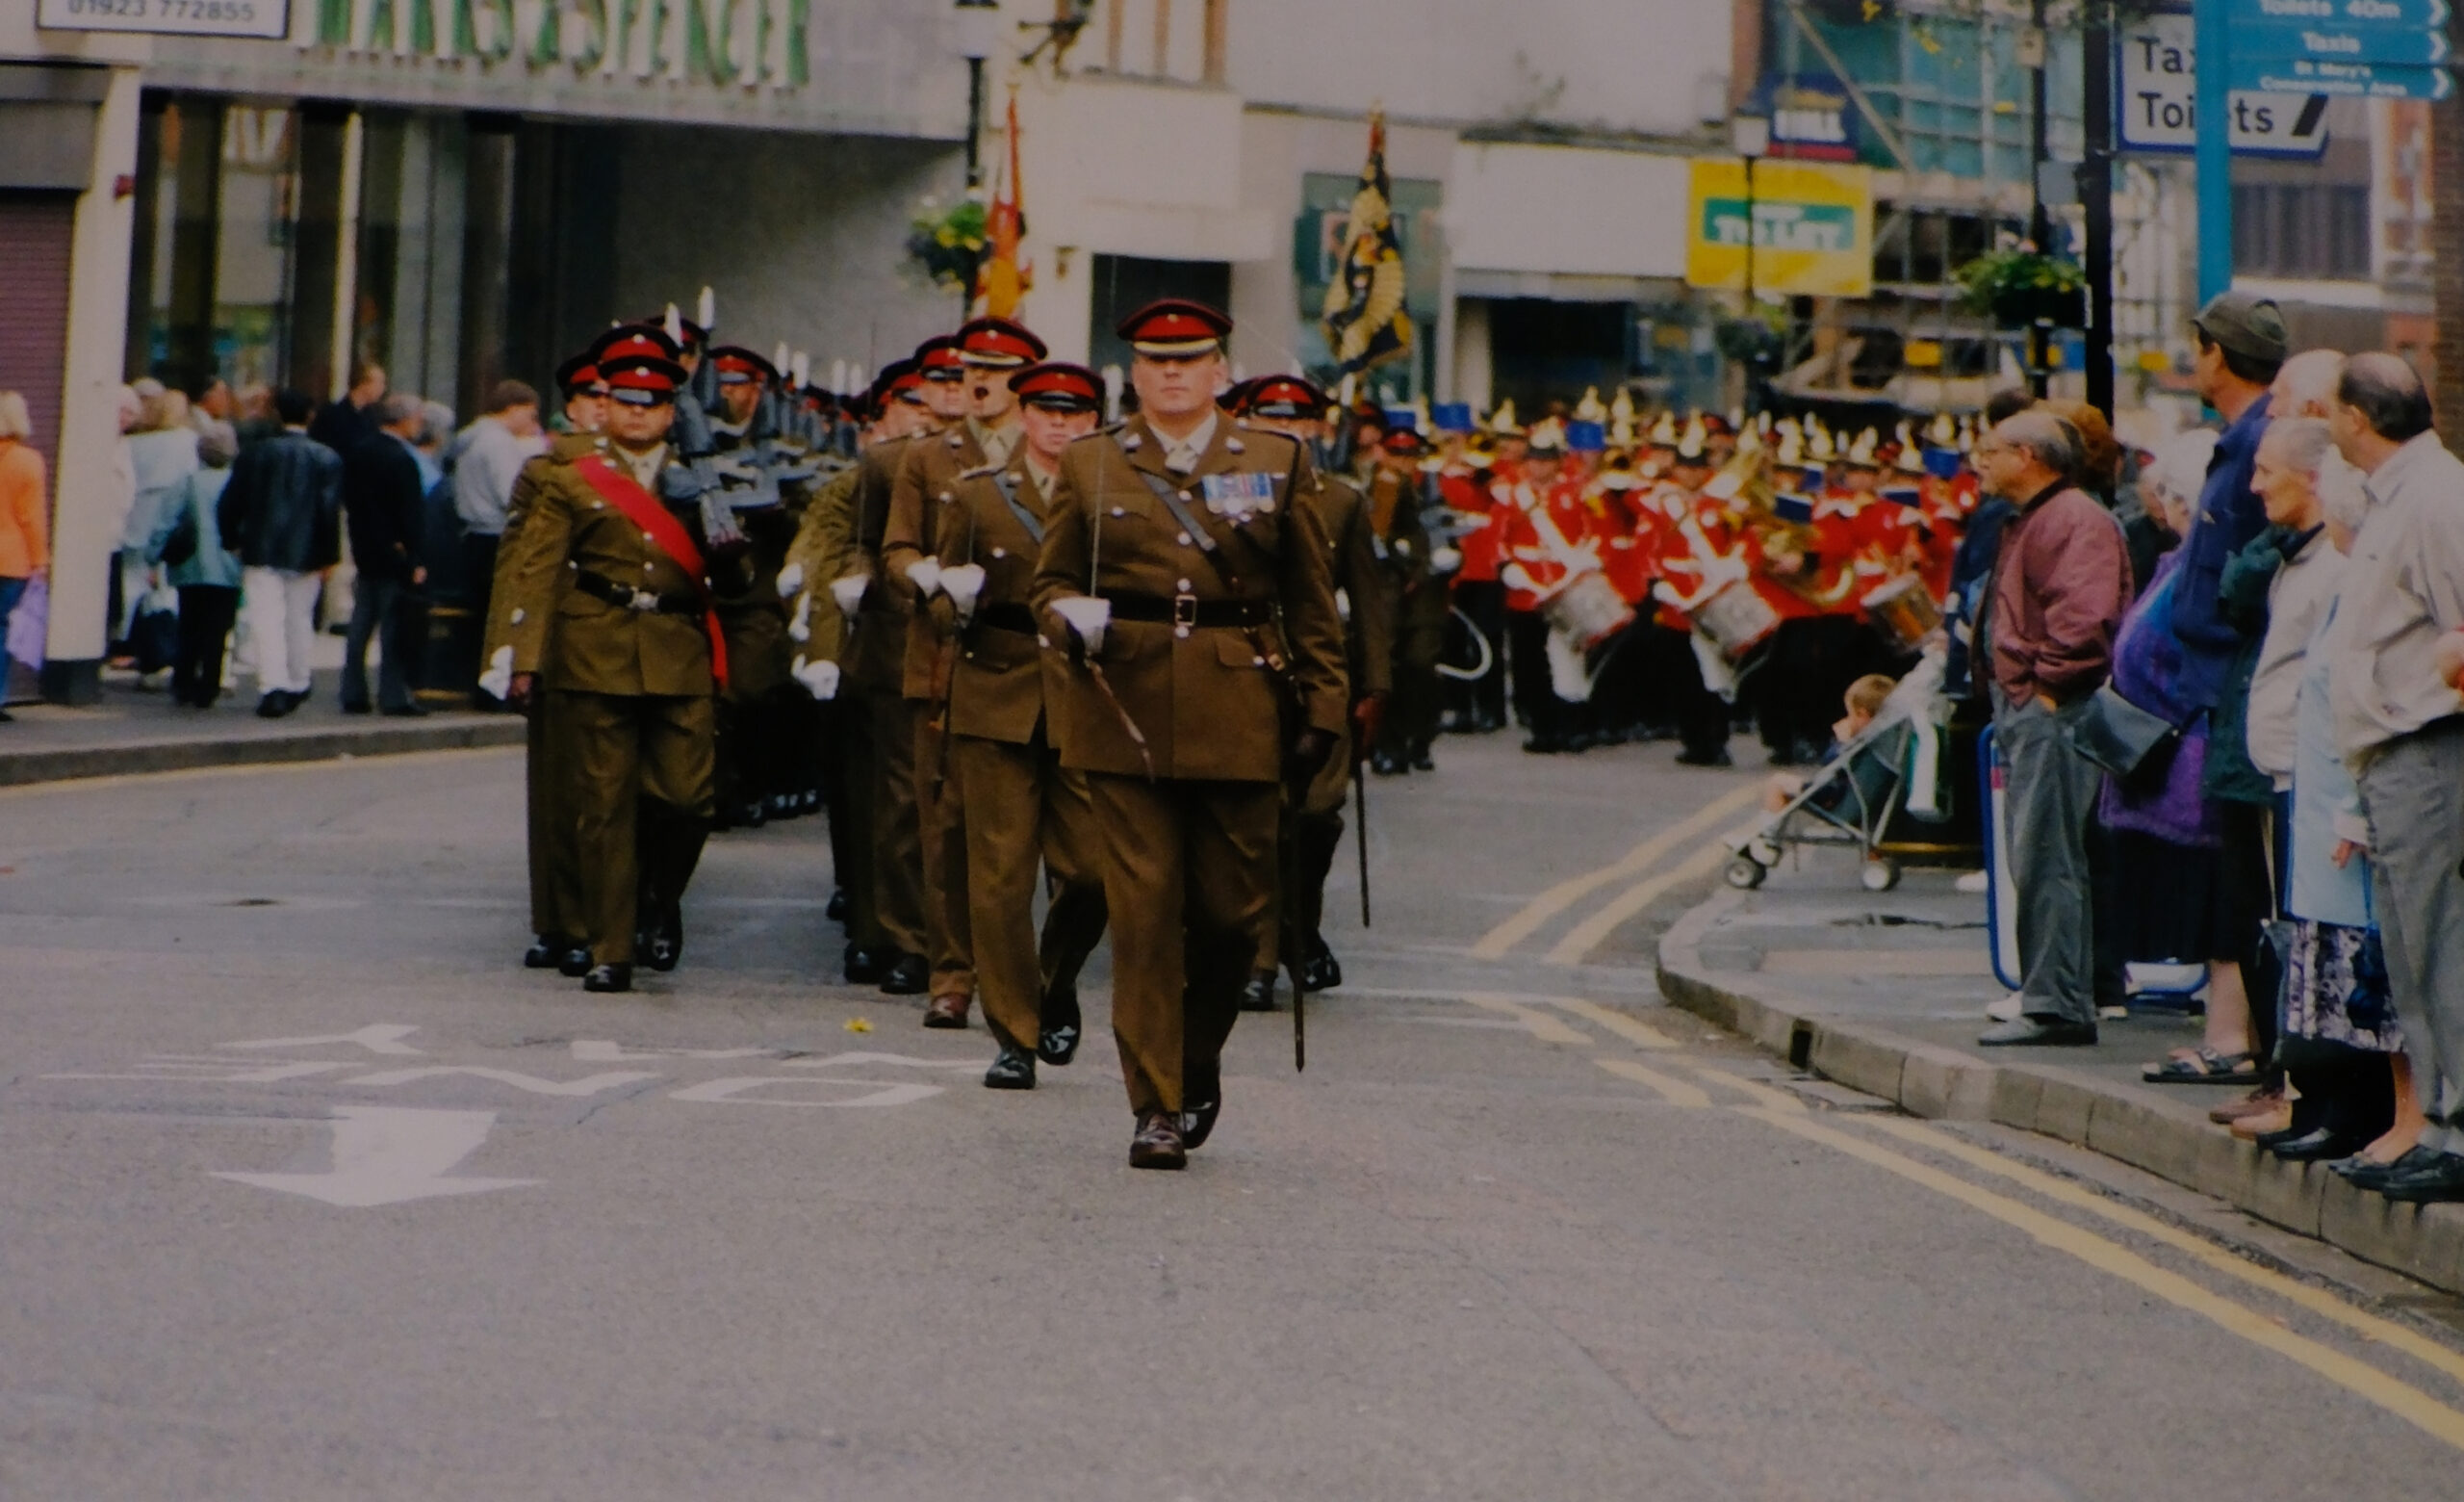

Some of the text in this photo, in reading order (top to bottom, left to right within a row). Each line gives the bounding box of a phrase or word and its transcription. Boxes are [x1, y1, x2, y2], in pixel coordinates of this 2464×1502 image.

[160, 0, 255, 21] 772855
[2138, 91, 2274, 134] Toits
[1773, 218, 1841, 249] LET
